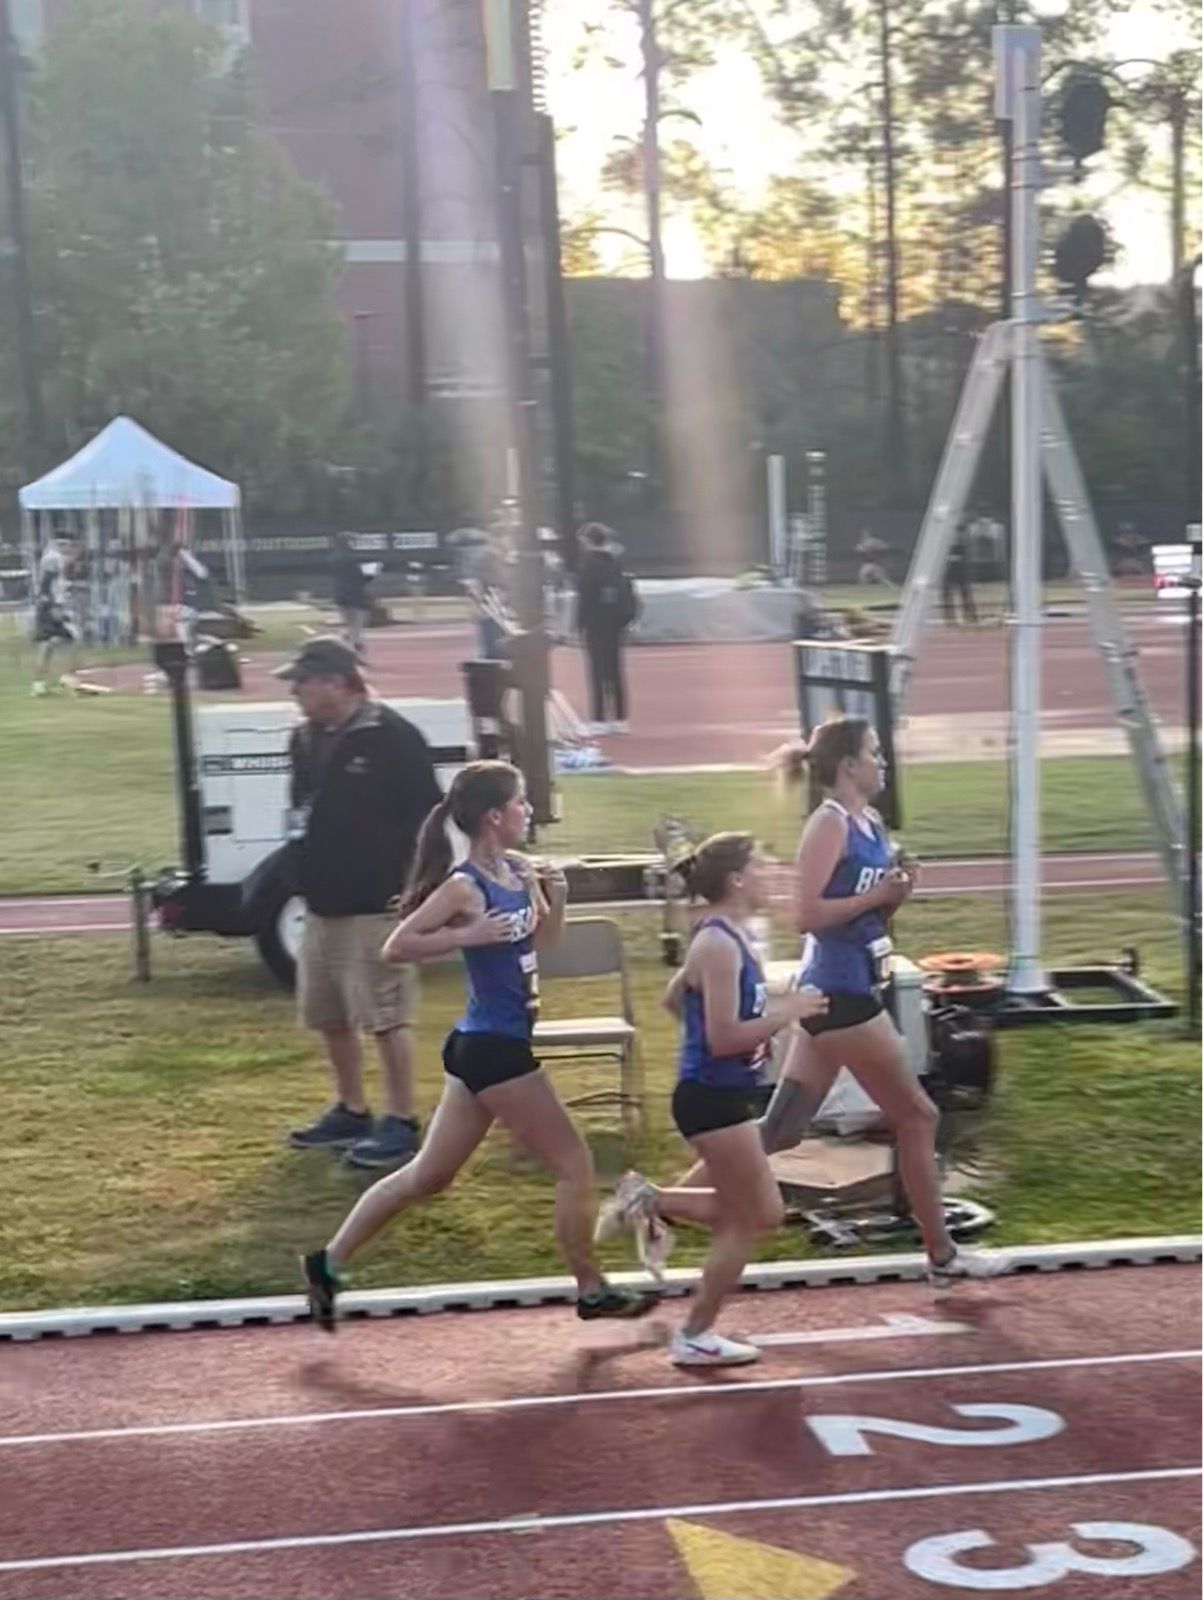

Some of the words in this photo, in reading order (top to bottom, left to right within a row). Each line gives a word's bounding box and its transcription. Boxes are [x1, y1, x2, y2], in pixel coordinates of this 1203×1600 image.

[748, 1315, 976, 1346] 1
[806, 1403, 1066, 1456] 2
[903, 1521, 1197, 1590] 3
